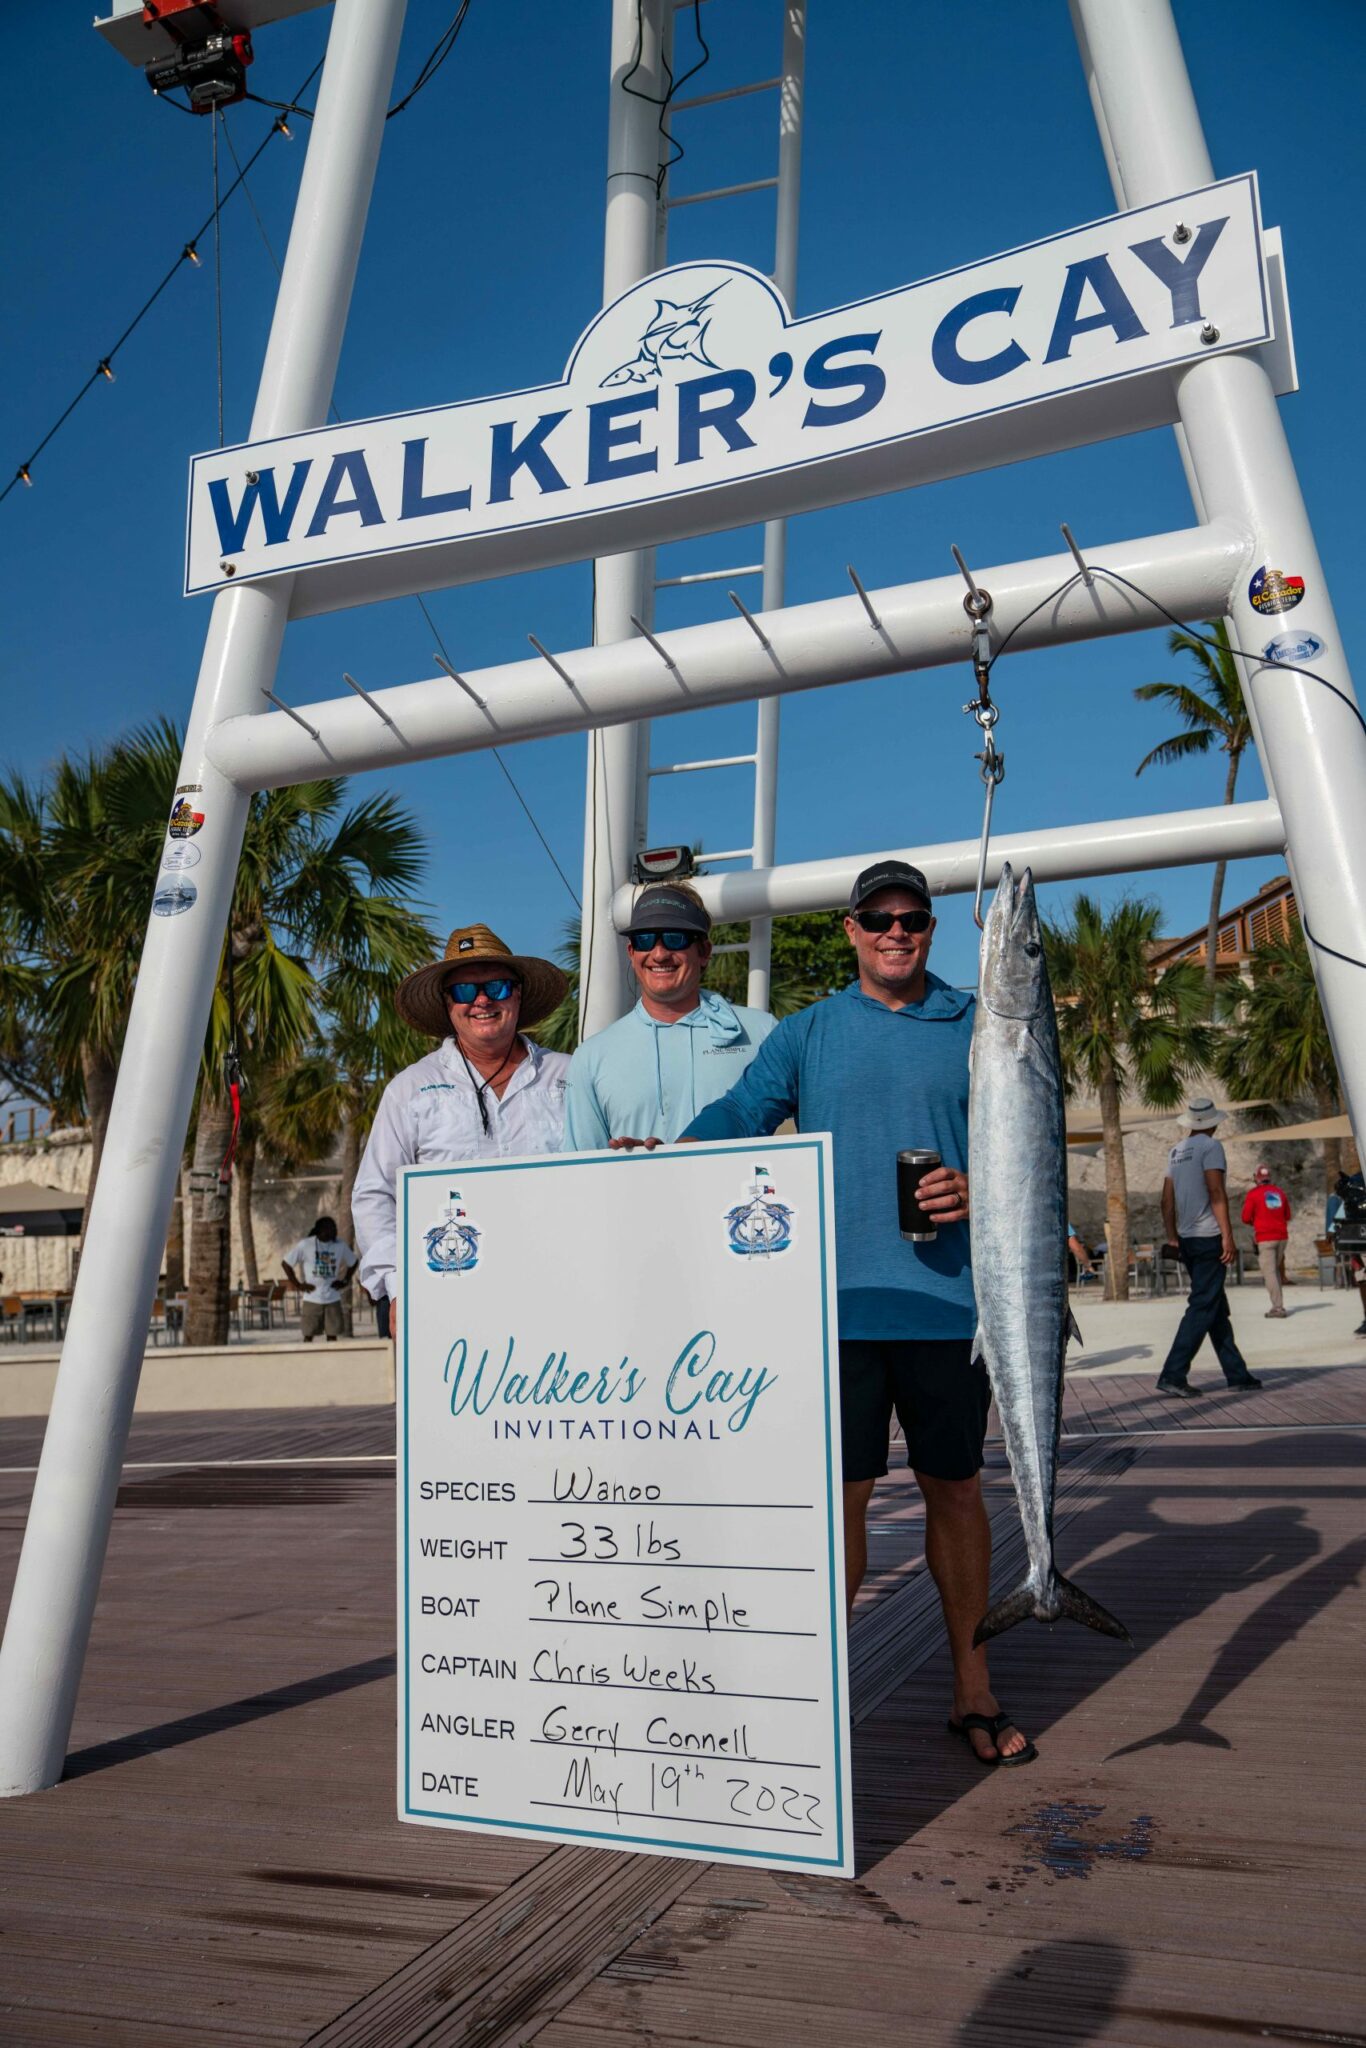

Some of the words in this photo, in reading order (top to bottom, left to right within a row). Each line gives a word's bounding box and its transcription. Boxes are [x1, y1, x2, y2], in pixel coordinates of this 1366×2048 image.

[207, 329, 887, 557] WALKER'S
[931, 216, 1231, 385] CAY
[444, 1336, 647, 1416] Walker's
[665, 1330, 779, 1432] Cay
[494, 1420, 721, 1440] INVITATIONAL
[420, 1481, 516, 1502] SPECIES
[420, 1538, 508, 1560] WEIGHT
[560, 1522, 618, 1560] 33
[636, 1521, 681, 1561] lbs
[420, 1596, 480, 1618] BOAT
[534, 1580, 622, 1619] Plane
[640, 1585, 750, 1632] Simple
[421, 1654, 517, 1679] CAPTAIN
[532, 1649, 611, 1684] Chris
[623, 1653, 717, 1694] Weeks
[421, 1713, 515, 1741] ANGLER
[542, 1705, 619, 1757] Gerry
[646, 1717, 757, 1760] Connell
[421, 1772, 479, 1797] DATE
[563, 1757, 624, 1825] May
[726, 1779, 824, 1830] 2022
